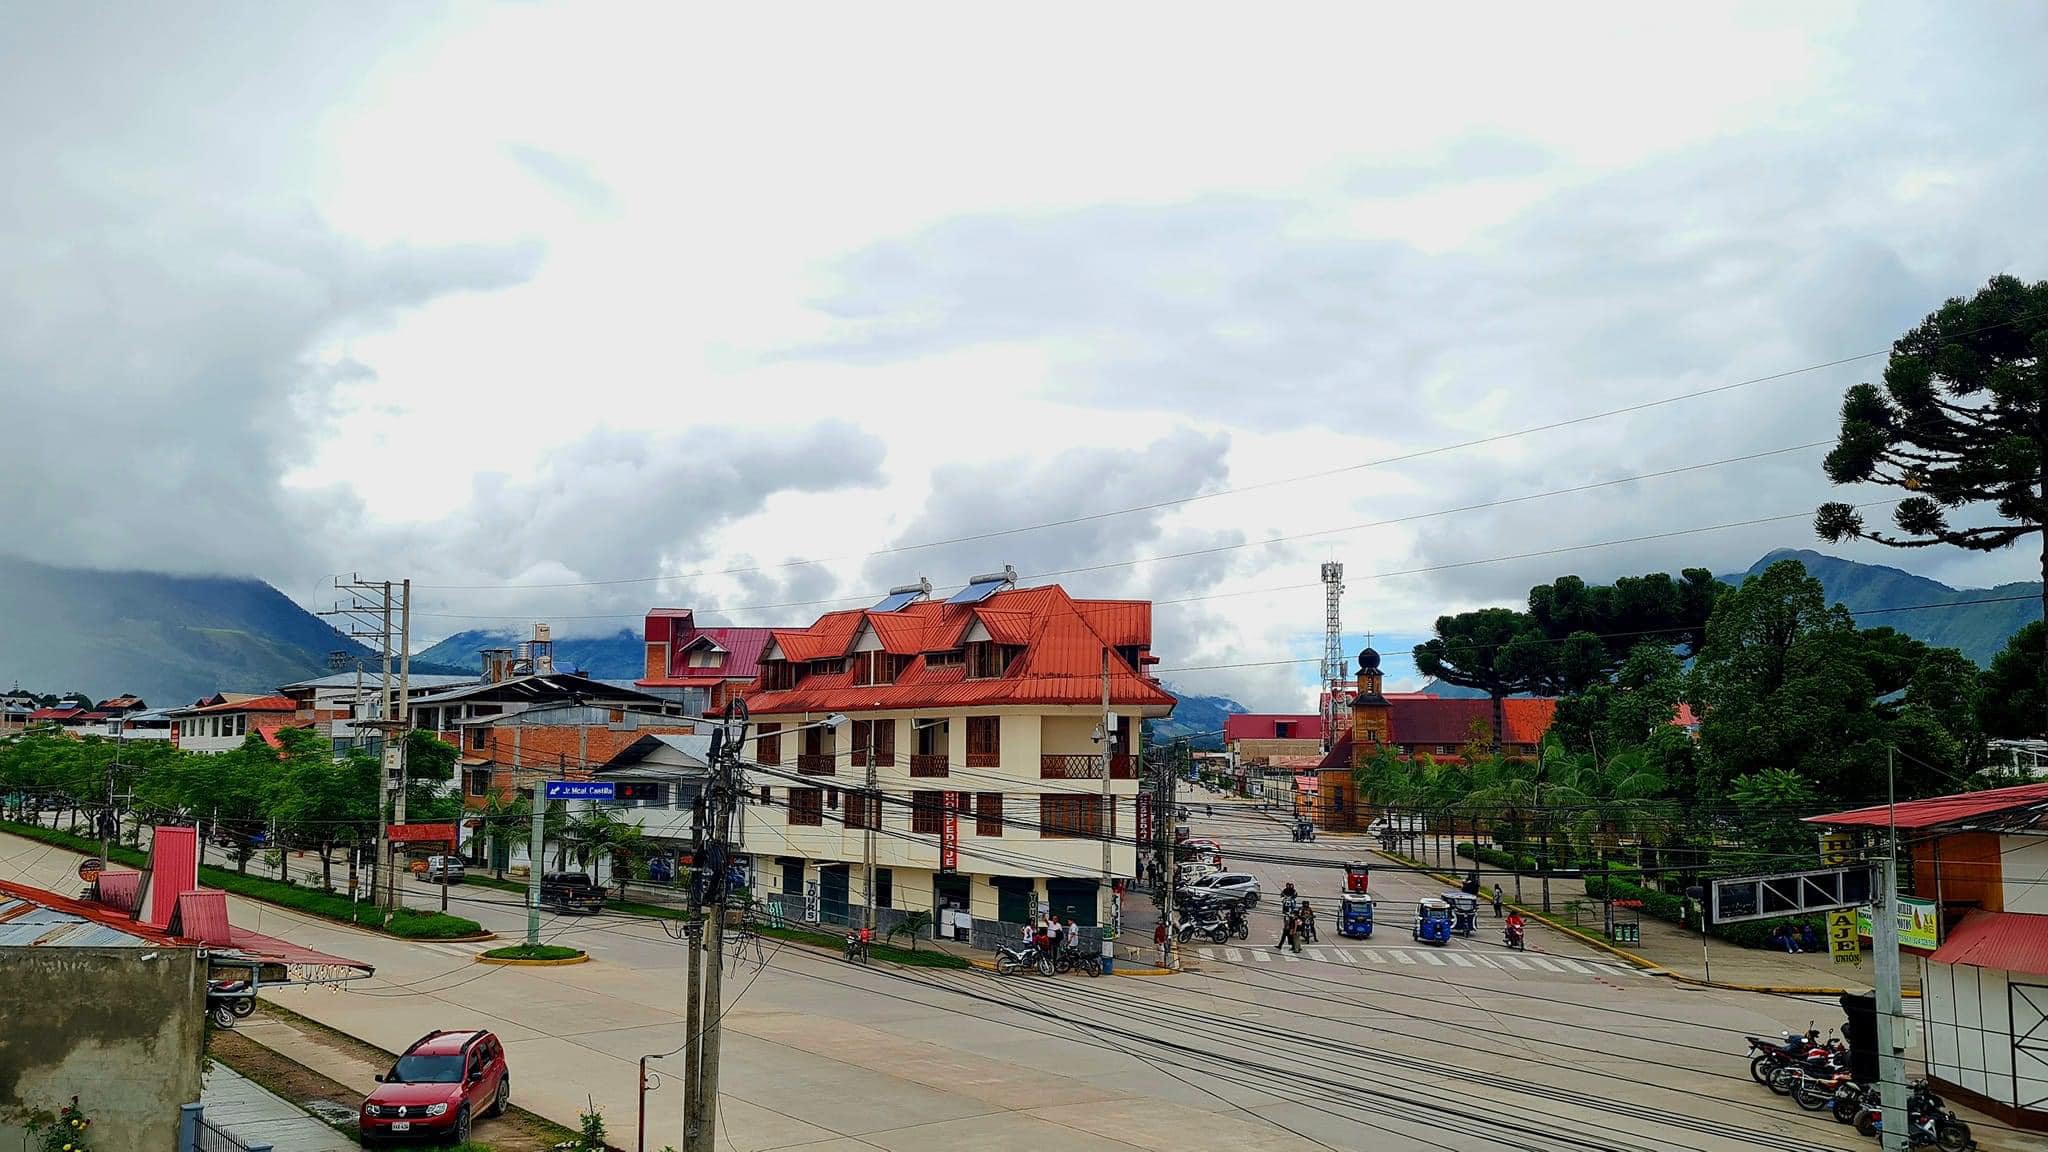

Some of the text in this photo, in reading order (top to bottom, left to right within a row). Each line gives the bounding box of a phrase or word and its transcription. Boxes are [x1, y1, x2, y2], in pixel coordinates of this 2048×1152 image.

[589, 786, 613, 795] Castilla
[807, 882, 816, 920] TOURS
[1835, 953, 1860, 962] UNIÓN
